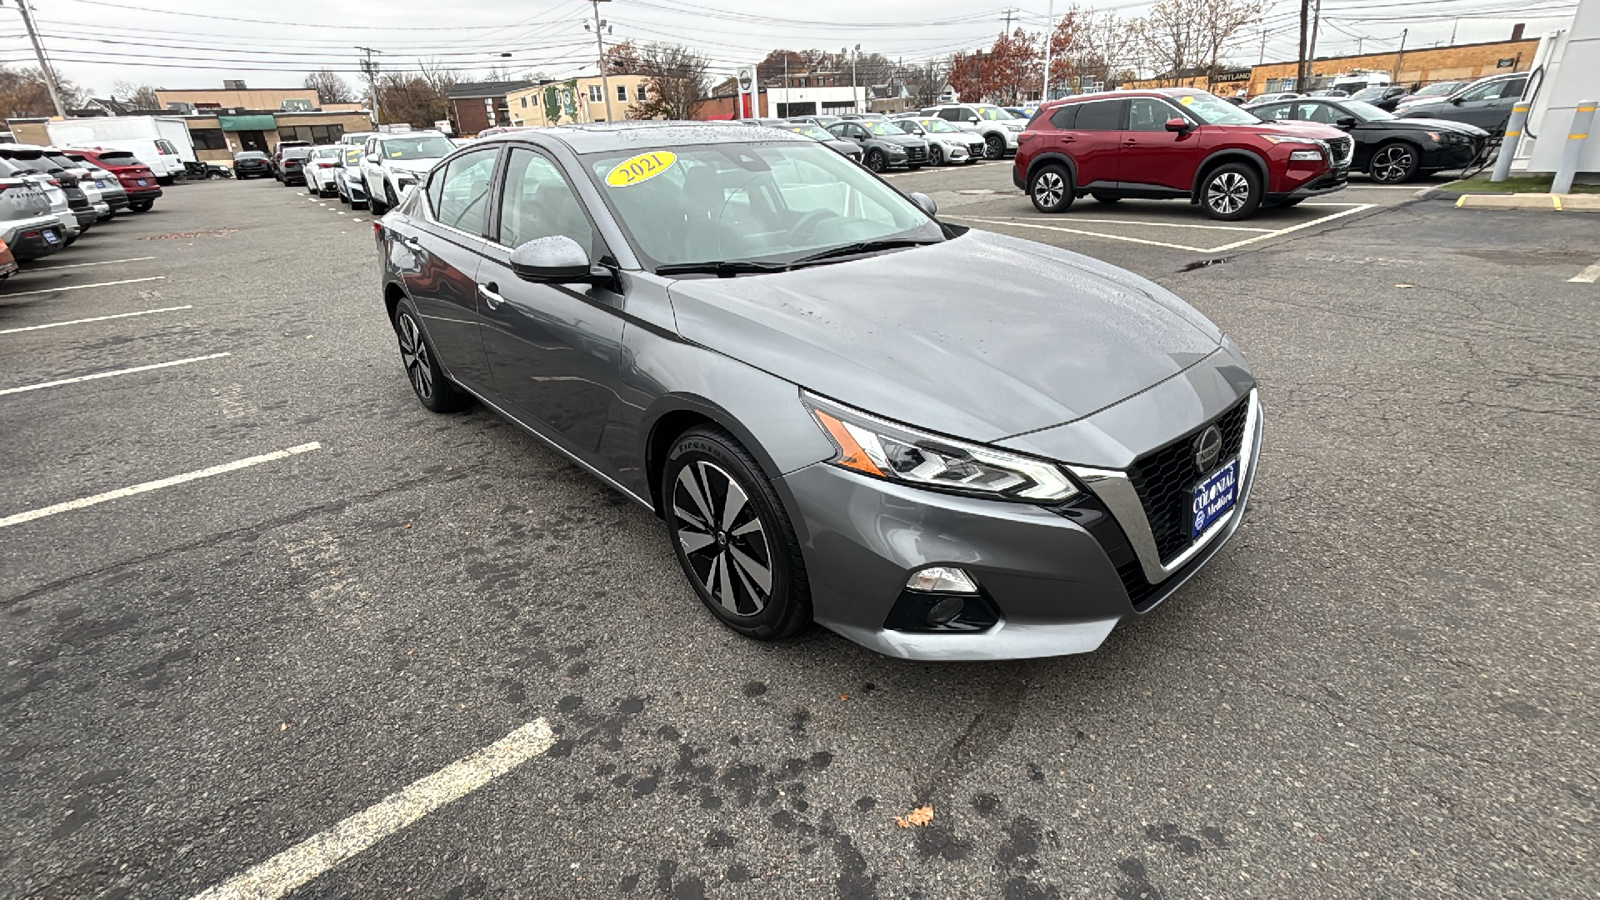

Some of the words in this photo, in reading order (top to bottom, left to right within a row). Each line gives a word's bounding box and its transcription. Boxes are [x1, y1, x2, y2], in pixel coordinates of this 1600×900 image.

[619, 154, 664, 182] 2021
[1193, 471, 1235, 513] COLONIAL
[1207, 488, 1233, 519] Medford
